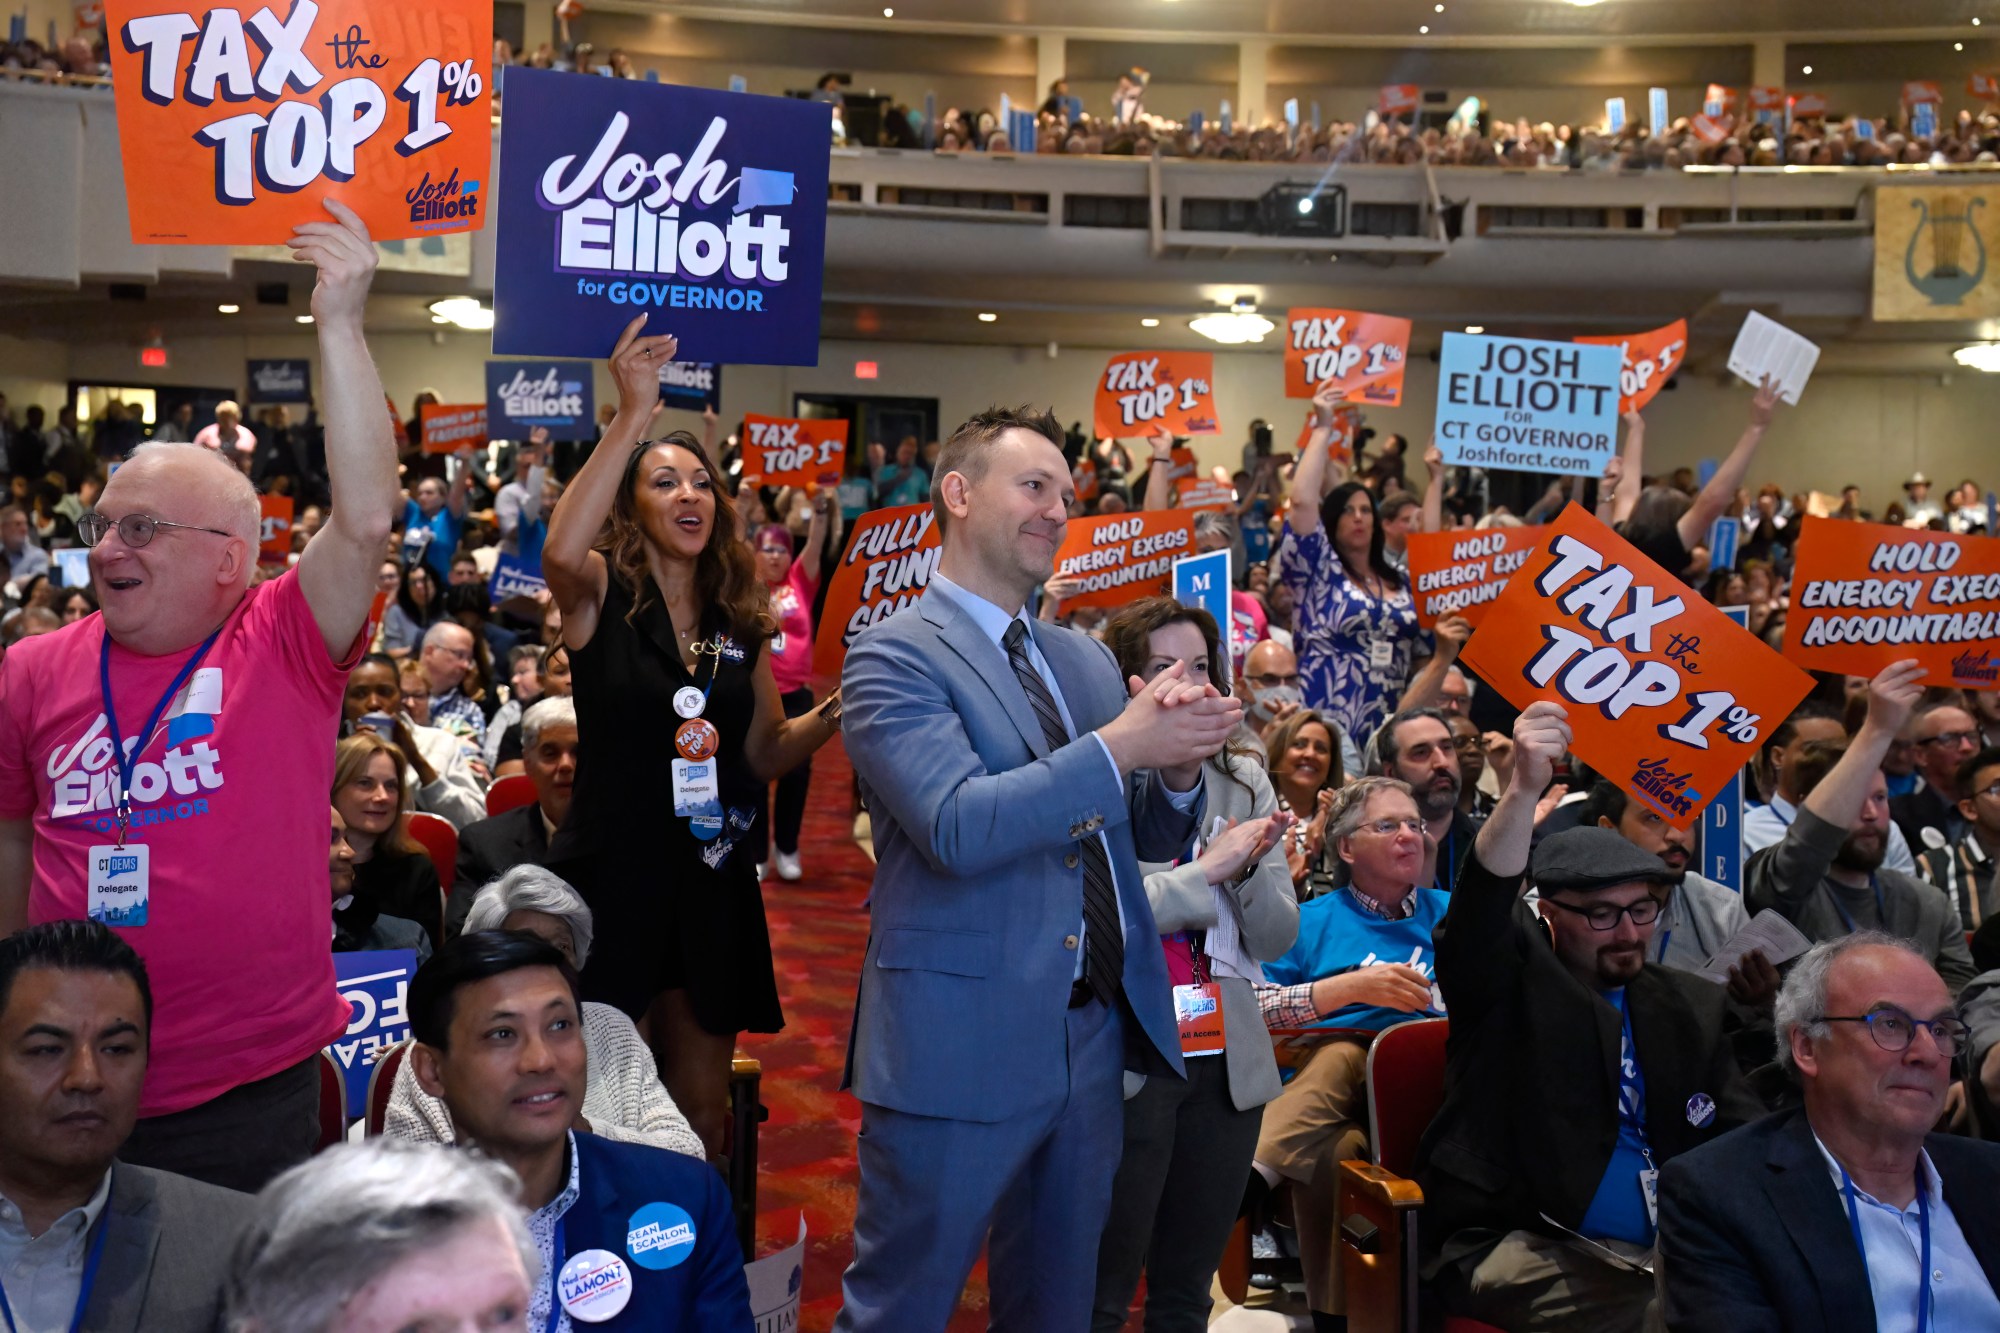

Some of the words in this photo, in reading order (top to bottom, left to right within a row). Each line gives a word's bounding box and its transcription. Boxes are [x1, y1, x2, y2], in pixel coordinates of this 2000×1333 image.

[121, 0, 325, 106] TAX
[325, 25, 389, 69] the
[192, 76, 388, 206] TOP
[394, 58, 482, 158] 1%
[536, 111, 738, 212] Josh
[405, 167, 460, 204] Josh
[410, 195, 477, 222] Elliott
[553, 198, 790, 286] Elliott
[577, 279, 604, 296] for
[608, 281, 763, 312] GOVERNOR
[1292, 316, 1346, 350] TAX
[1106, 357, 1159, 392] TAX
[1303, 344, 1363, 385] TOP
[1362, 342, 1402, 375] 1%
[1479, 342, 1580, 379] JOSH
[497, 367, 560, 399] Josh
[1448, 372, 1612, 416] ELLIOTT
[1618, 361, 1655, 397] OP
[504, 394, 583, 417] Elliott
[1117, 383, 1175, 426] TOP
[1178, 378, 1209, 411] 1%
[1504, 411, 1533, 424] FOR
[749, 423, 800, 447] TAX
[1442, 420, 1470, 439] CT
[1476, 425, 1609, 452] GOVERNOR
[763, 444, 814, 475] TOP
[1457, 445, 1590, 471] Joshforct.com
[845, 509, 936, 567] FULLY
[1092, 517, 1145, 546] HOLD
[1453, 533, 1507, 562] HOLD
[1060, 546, 1126, 575] ENERGY
[1131, 528, 1189, 558] EXECS
[1870, 541, 1961, 572] HOLD
[1417, 561, 1488, 592] ENERGY
[1493, 546, 1535, 574] EXE
[1534, 534, 1686, 653] TAX
[1663, 632, 1702, 675] the
[1801, 578, 1923, 611] ENERGY
[1929, 573, 2000, 606] EXEC
[1522, 624, 1681, 721] TOP
[1657, 691, 1762, 750] 1%
[1637, 757, 1693, 790] Josh
[1631, 769, 1693, 817] Elliott
[99, 859, 109, 871] CT
[112, 858, 136, 870] DEMS
[98, 885, 138, 894] Delegate
[1194, 1030, 1221, 1038] Access
[628, 1225, 658, 1242] SEAN
[635, 1226, 687, 1251] SCANLON
[565, 1265, 622, 1300] LAMONT
